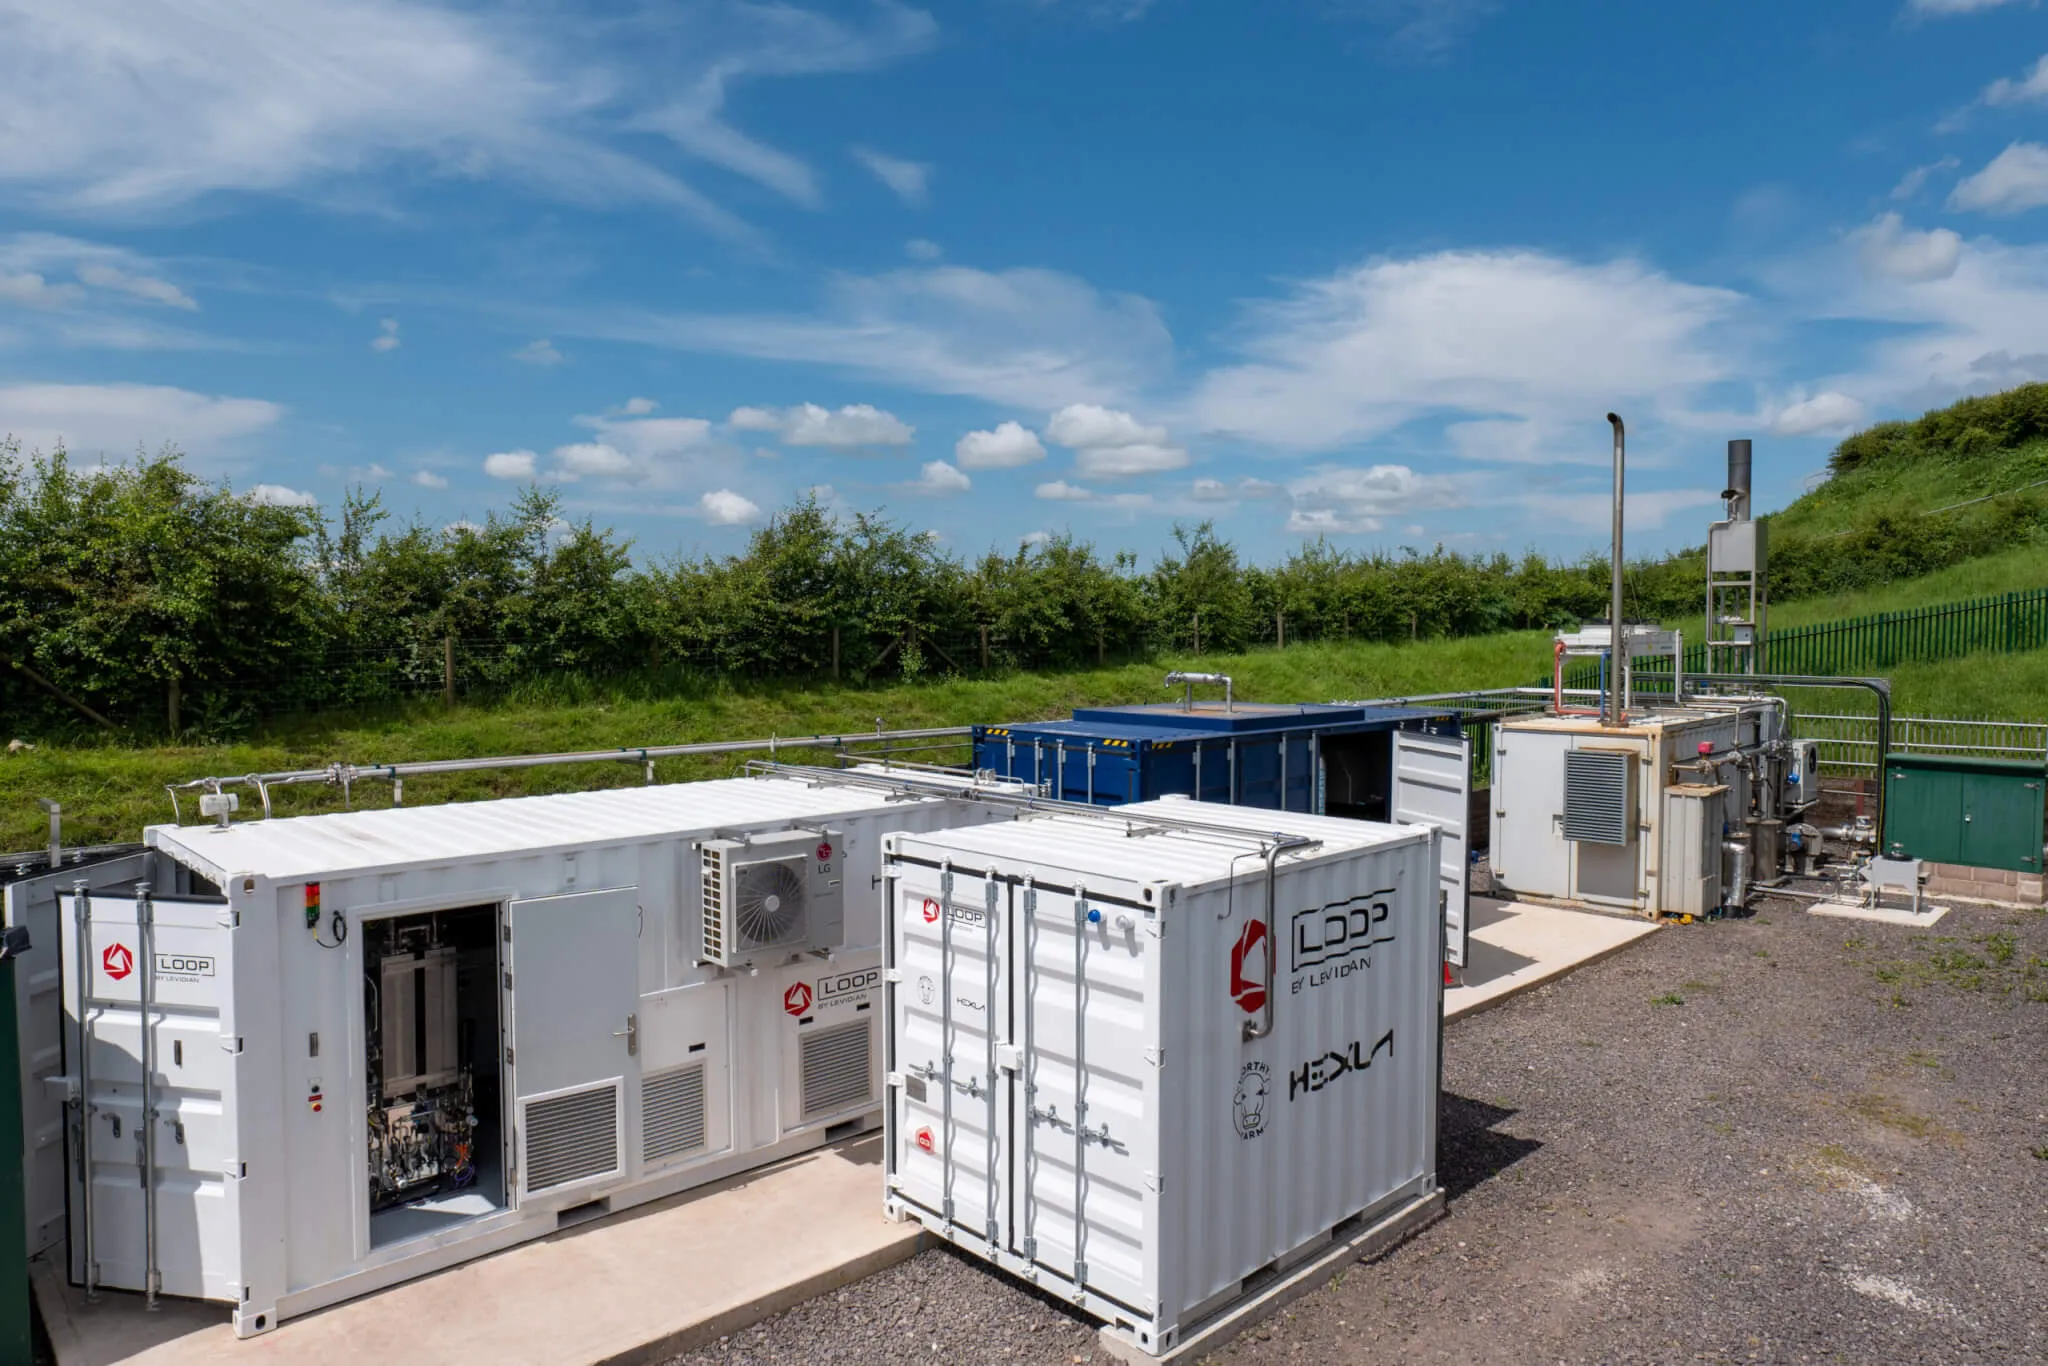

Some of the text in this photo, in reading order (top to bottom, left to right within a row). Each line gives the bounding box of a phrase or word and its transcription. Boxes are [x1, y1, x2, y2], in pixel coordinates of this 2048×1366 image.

[818, 863, 831, 874] LG
[947, 906, 982, 922] LOOP
[1300, 902, 1389, 954] LOOP
[161, 958, 209, 972] LOOP
[825, 971, 878, 995] LOOP
[830, 993, 867, 1007] LEVIDIAN
[1242, 1126, 1265, 1141] ARM
